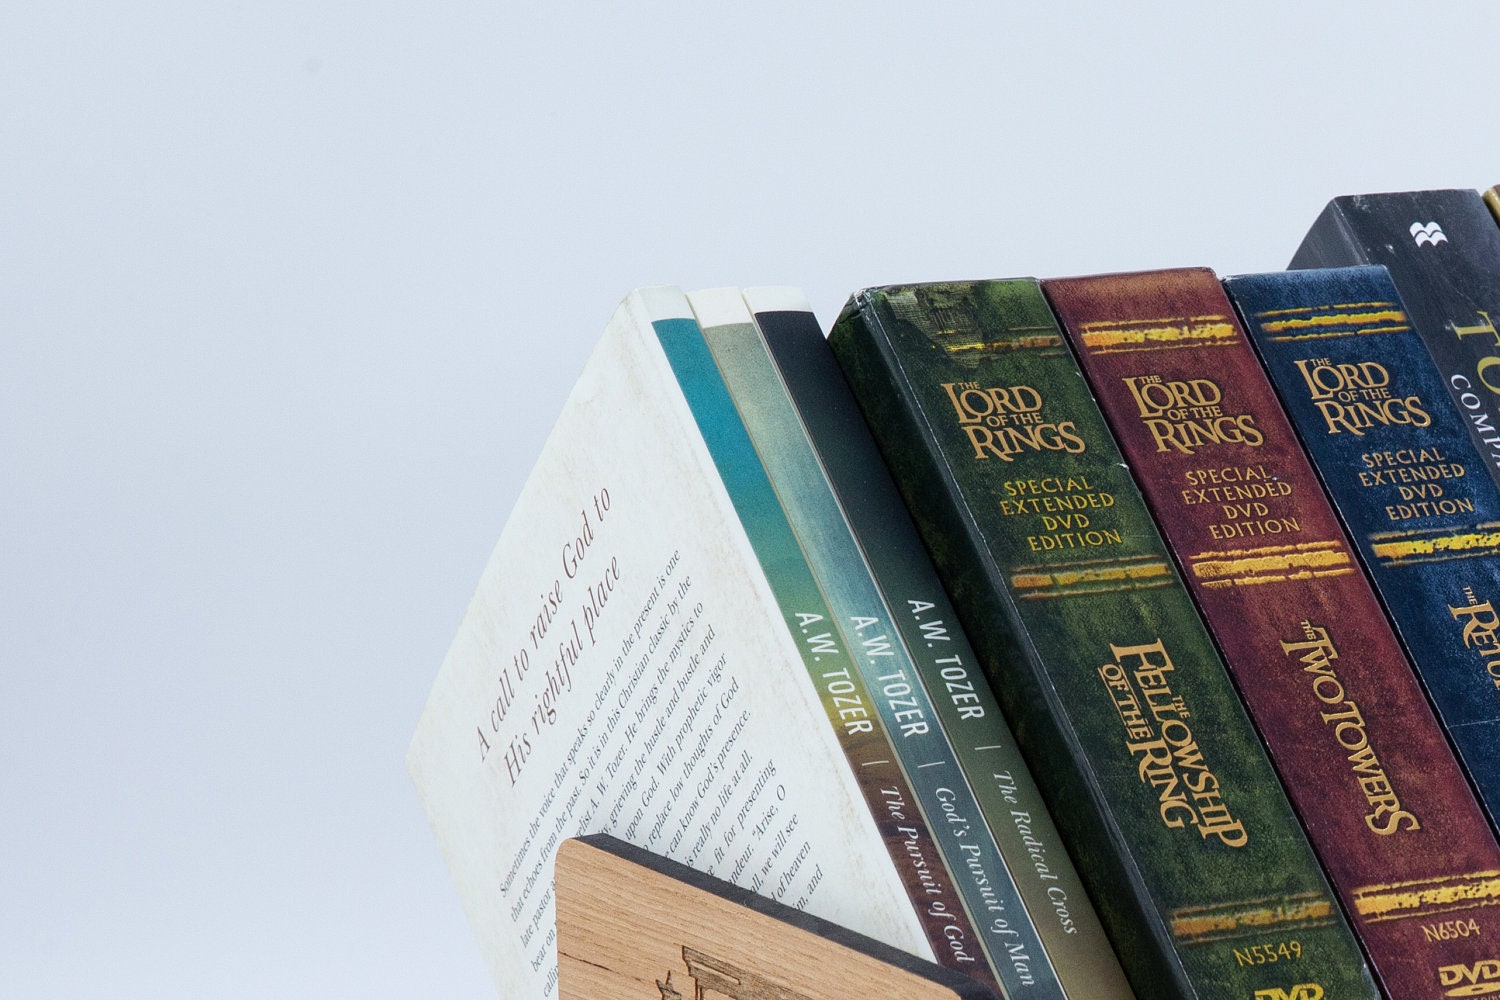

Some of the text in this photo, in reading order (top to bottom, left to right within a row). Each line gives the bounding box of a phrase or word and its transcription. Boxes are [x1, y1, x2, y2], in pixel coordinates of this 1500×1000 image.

[1311, 357, 1332, 367] THE
[957, 380, 981, 391] THE
[1139, 375, 1162, 386] THE
[1294, 359, 1390, 401] LORD
[941, 383, 1043, 427] LORD
[1122, 377, 1222, 420] LORD
[1339, 386, 1392, 401] OF THE
[986, 412, 1043, 427] OF THE
[1167, 405, 1223, 421] OF THE
[1314, 397, 1432, 436] RINGS
[965, 422, 1086, 461] RINGS
[1144, 416, 1263, 454] RINGS
[1361, 447, 1445, 468] SPECIAL
[1003, 478, 1094, 497] SPECIAL
[1184, 467, 1272, 486] SPECIAL
[1358, 463, 1466, 487] EXTENDED
[999, 493, 1115, 516] EXTENDED
[1181, 481, 1292, 506] EXTENDED
[1399, 483, 1444, 501] DVD
[1221, 501, 1268, 520] DVD
[1385, 498, 1474, 521] EDITION
[1042, 514, 1091, 532] DVD
[1209, 517, 1301, 541] EDITION
[1027, 529, 1123, 552] EDITION
[1462, 586, 1478, 605] THE
[477, 487, 611, 761] A call to raise God to
[1300, 619, 1316, 640] THE
[503, 556, 620, 788] His rightful place
[907, 599, 986, 721] A.W. TOZER
[795, 612, 873, 736] A.W. TOZER
[850, 615, 929, 738] A.W. TOZER
[1102, 663, 1150, 740] OF THE
[1172, 695, 1190, 719] THE
[499, 550, 680, 898] Sometimes the voice that speaks so clearly in the present is one
[1279, 627, 1421, 835] TWO TOWERS
[1109, 638, 1248, 848] FELLOWSHIP
[1126, 738, 1198, 828] RING
[993, 770, 1077, 935] The Radical Cross
[880, 785, 975, 963] The Pursuit of God
[935, 787, 1035, 987] God's Pursuit of Man
[1421, 918, 1481, 943] N6504
[1233, 940, 1303, 967] N5549
